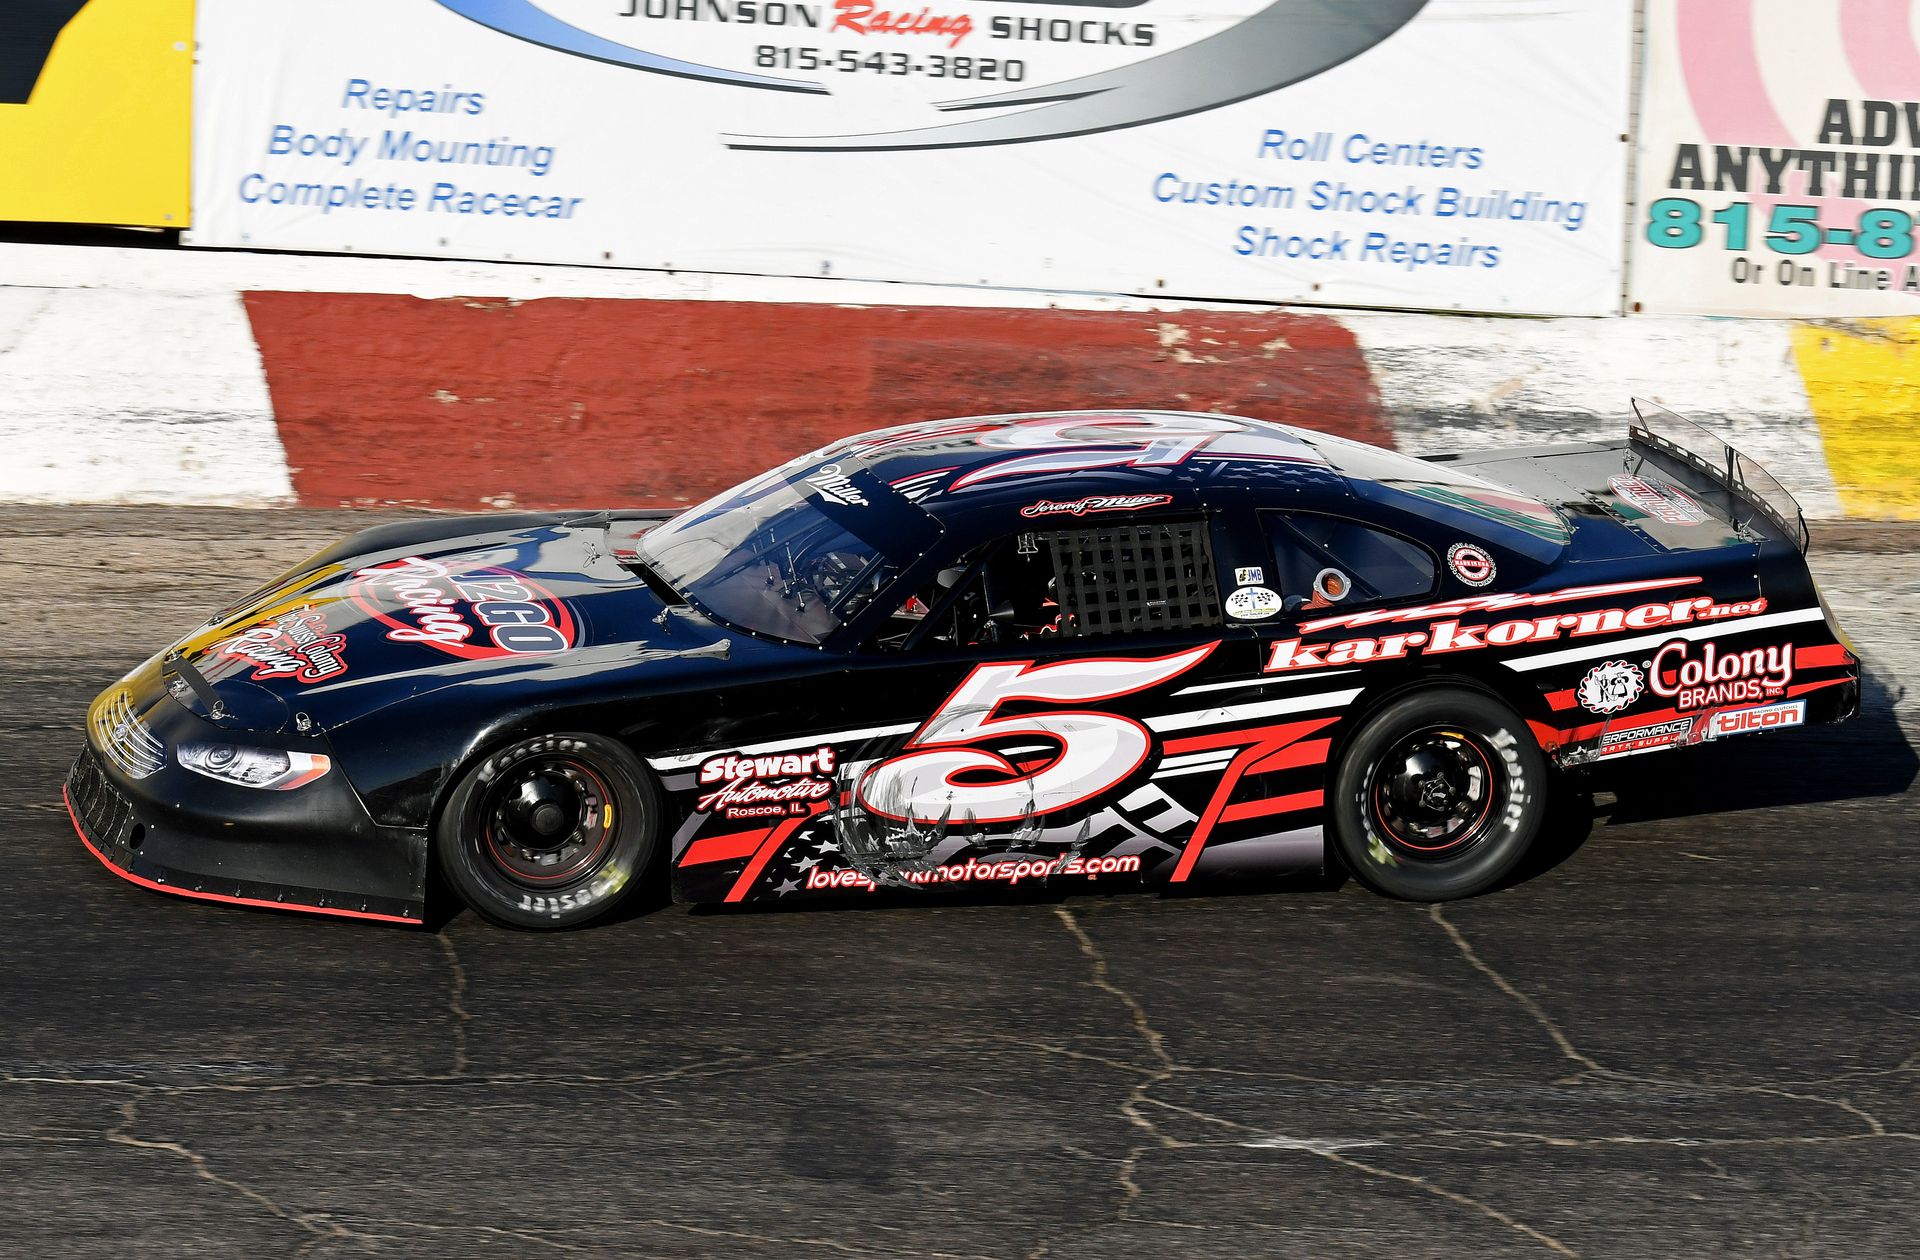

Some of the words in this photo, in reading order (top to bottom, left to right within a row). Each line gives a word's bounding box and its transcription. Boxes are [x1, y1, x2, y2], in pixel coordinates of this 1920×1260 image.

[619, 0, 822, 28] JOHNSON
[831, 0, 973, 46] Racing
[989, 15, 1156, 47] SHOCKS
[755, 45, 1025, 83] 815-543-3820
[342, 78, 486, 116] Repairs
[268, 124, 368, 167] Body
[377, 129, 556, 177] Mounting
[1258, 128, 1330, 162] Roll
[1343, 133, 1484, 170] Centers
[239, 172, 416, 213] Complete
[427, 182, 583, 220] Racecar
[1153, 172, 1295, 208] Custom
[1307, 179, 1421, 216] Shock
[1433, 187, 1587, 231] Building
[1233, 225, 1349, 260] Shock
[1362, 231, 1502, 270] Repairs
[1647, 198, 1920, 260] 815-8
[1732, 257, 1763, 284] Or
[1778, 259, 1815, 286] On
[1830, 262, 1891, 290] Line
[805, 463, 869, 506] Miller
[1024, 500, 1088, 514] Jeremy
[1086, 496, 1164, 508] Miller
[356, 556, 473, 647] Racing
[447, 575, 569, 652] J2GO
[207, 627, 307, 676] Racing
[1263, 596, 1768, 674] karkorner.net
[1650, 641, 1792, 697] Colony
[1678, 680, 1764, 708] BRANDS,
[858, 639, 1223, 824] 5
[1602, 720, 1690, 745] ERFORMANCE
[1717, 709, 1798, 732] tilton
[700, 746, 833, 783] Stewart
[698, 777, 831, 811] Automotive
[727, 806, 786, 818] Roscoe,
[791, 803, 805, 813] IL
